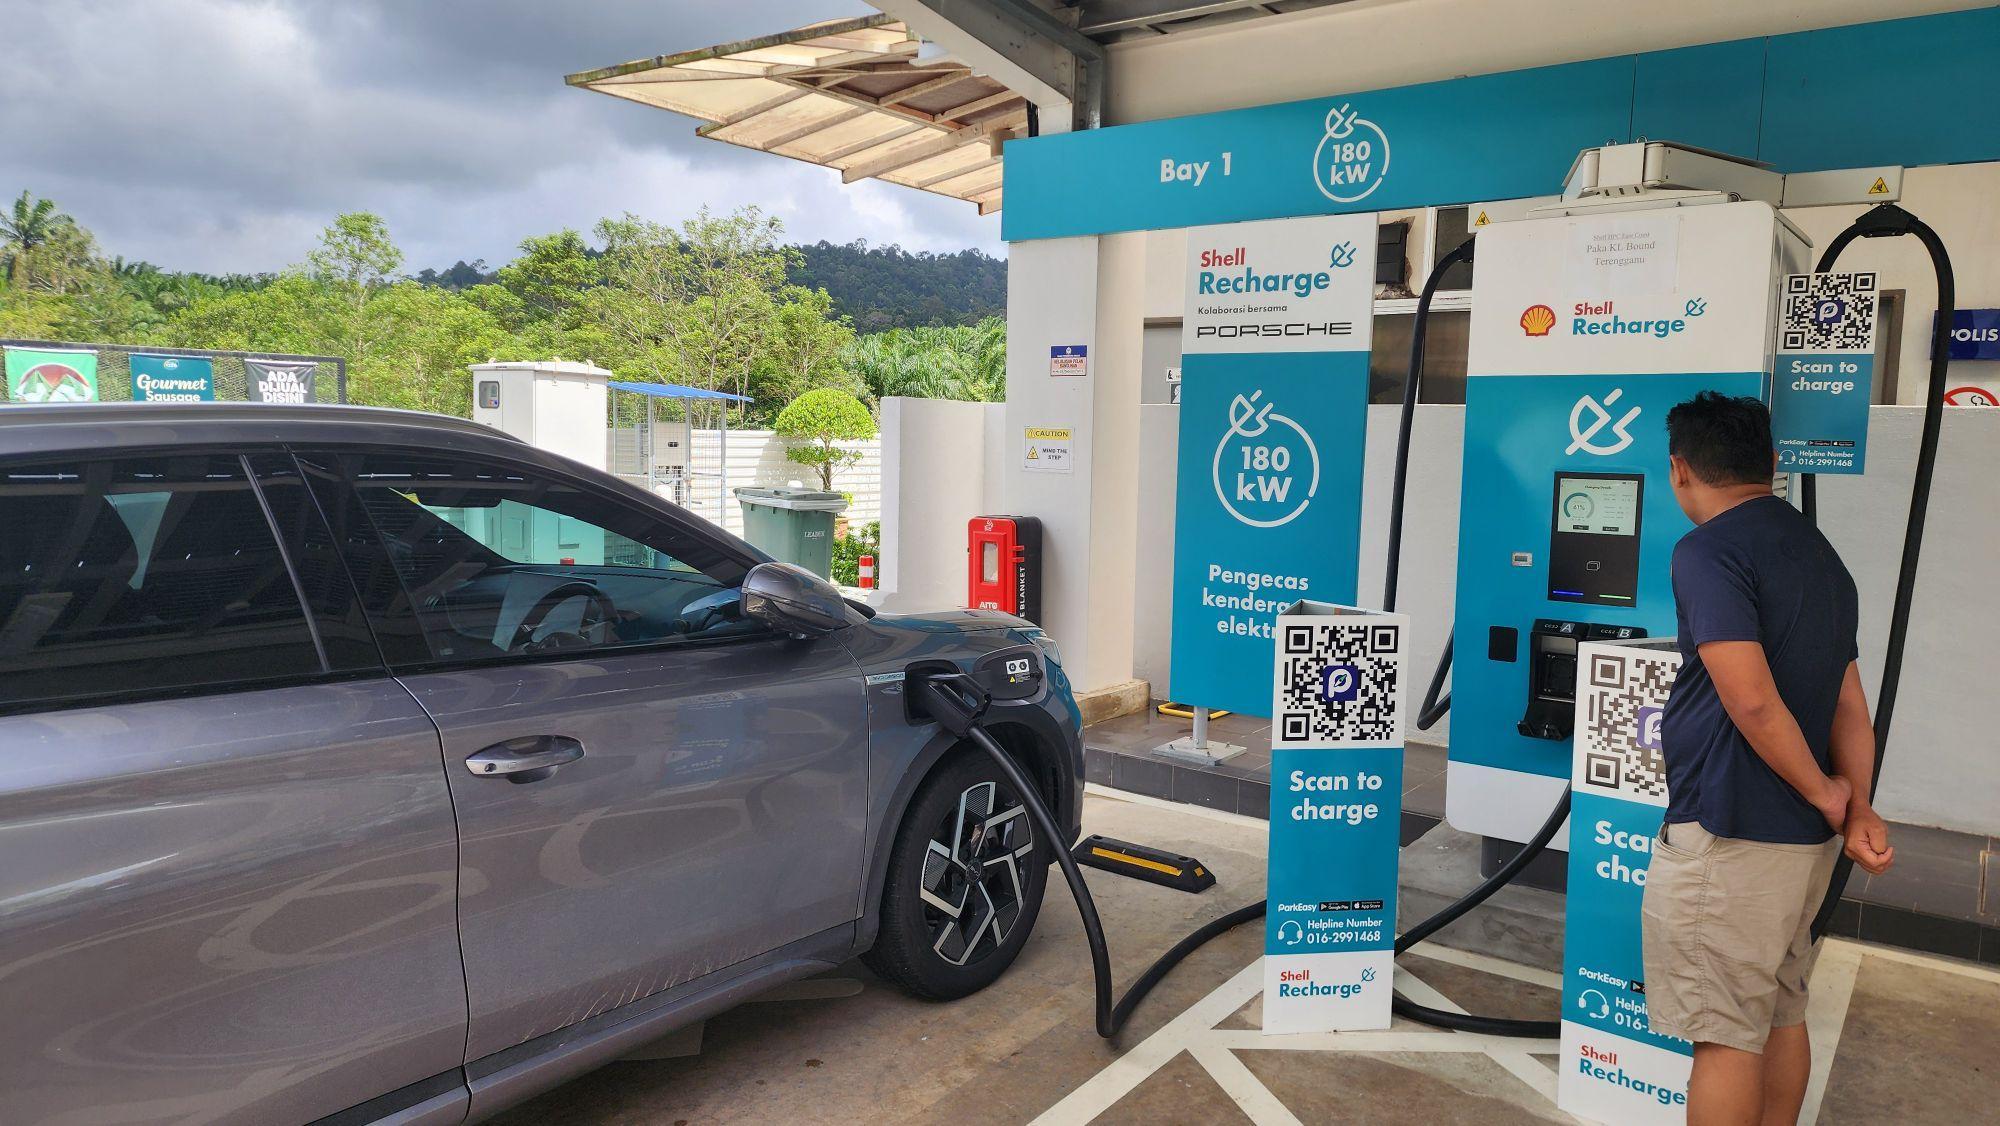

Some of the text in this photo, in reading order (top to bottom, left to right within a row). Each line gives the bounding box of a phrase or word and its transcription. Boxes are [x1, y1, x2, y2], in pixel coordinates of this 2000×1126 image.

[1332, 141, 1371, 163] 180
[1160, 151, 1232, 186] Bay 1
[1330, 162, 1371, 185] kW
[1586, 244, 1607, 253] Paka
[1626, 241, 1656, 251] Bound
[1200, 247, 1246, 267] Shell
[1595, 257, 1645, 266] Terengganu
[1199, 267, 1331, 298] Recharge
[1198, 304, 1288, 315] Kolaborasi bersama
[1574, 301, 1613, 316] Shell
[1197, 321, 1353, 338] PORSCHE
[1572, 315, 1685, 338] Recharge
[1951, 328, 1999, 341] OLIS
[1791, 360, 1858, 374] Scan to
[136, 373, 208, 391] Gourmet
[267, 371, 297, 382] ADA
[258, 381, 308, 394] DIJUAL
[1791, 377, 1855, 394] charge
[146, 390, 201, 402] Sausage
[1241, 446, 1290, 472] 180
[1798, 458, 1853, 467] 016-2991468
[1799, 450, 1826, 458] Helpline
[1237, 472, 1293, 503] kW
[1209, 564, 1309, 591] Pengecas
[1202, 587, 1291, 613] kendera
[1289, 770, 1383, 792] Scan to
[1291, 797, 1379, 825] charge
[1594, 820, 1656, 854] Sca
[1596, 854, 1648, 886] cha
[1278, 903, 1317, 912] ParkEasy
[1307, 917, 1383, 931] Helpline Number
[1307, 930, 1381, 944] 016-2991468
[1280, 969, 1310, 981] Shell
[1578, 967, 1627, 990] ParkEasy
[1279, 981, 1361, 998] Recharge
[1580, 1044, 1617, 1066] Shell
[1579, 1058, 1686, 1105] Recharge
